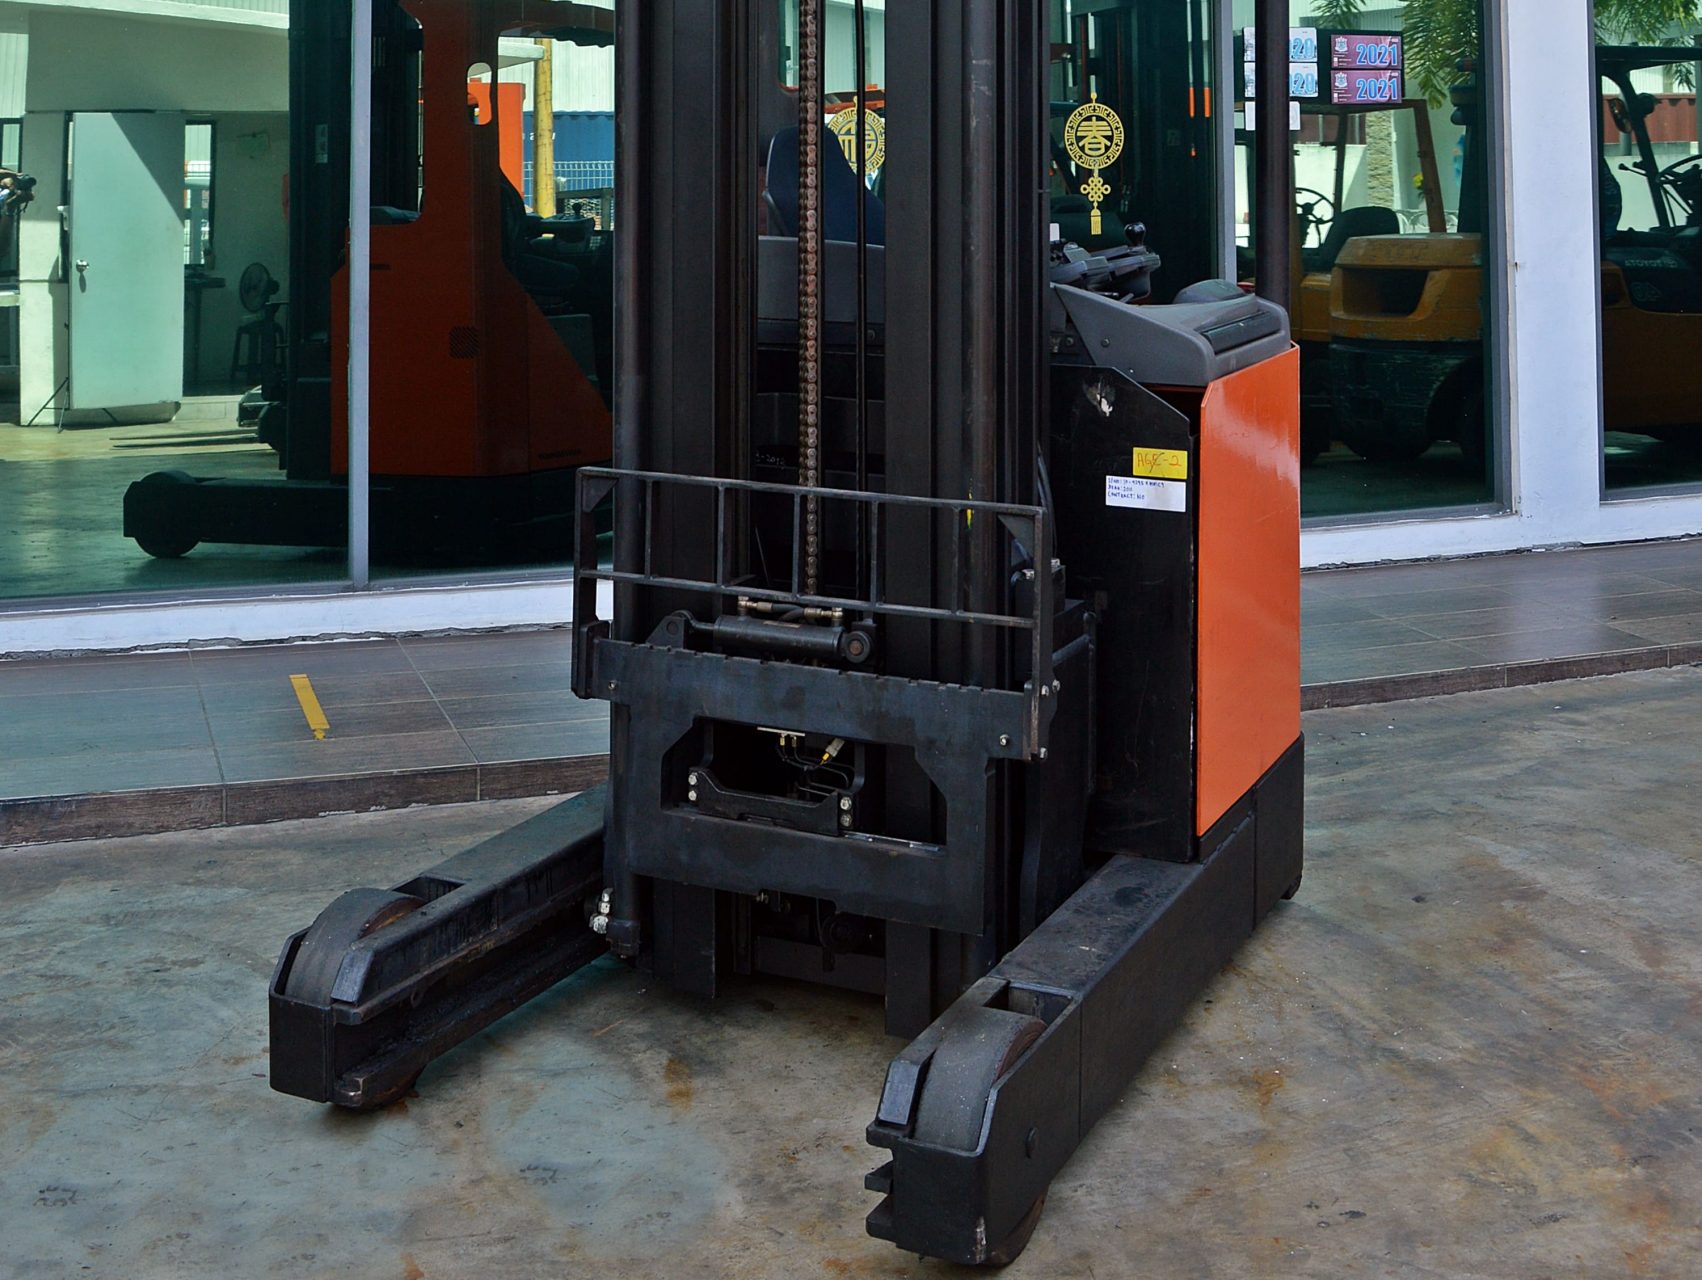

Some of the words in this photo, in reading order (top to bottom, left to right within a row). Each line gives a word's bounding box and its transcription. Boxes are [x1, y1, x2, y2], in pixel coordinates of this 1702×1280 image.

[1356, 43, 1398, 66] 2021
[1356, 78, 1398, 100] 2021
[1076, 116, 1113, 157] 春
